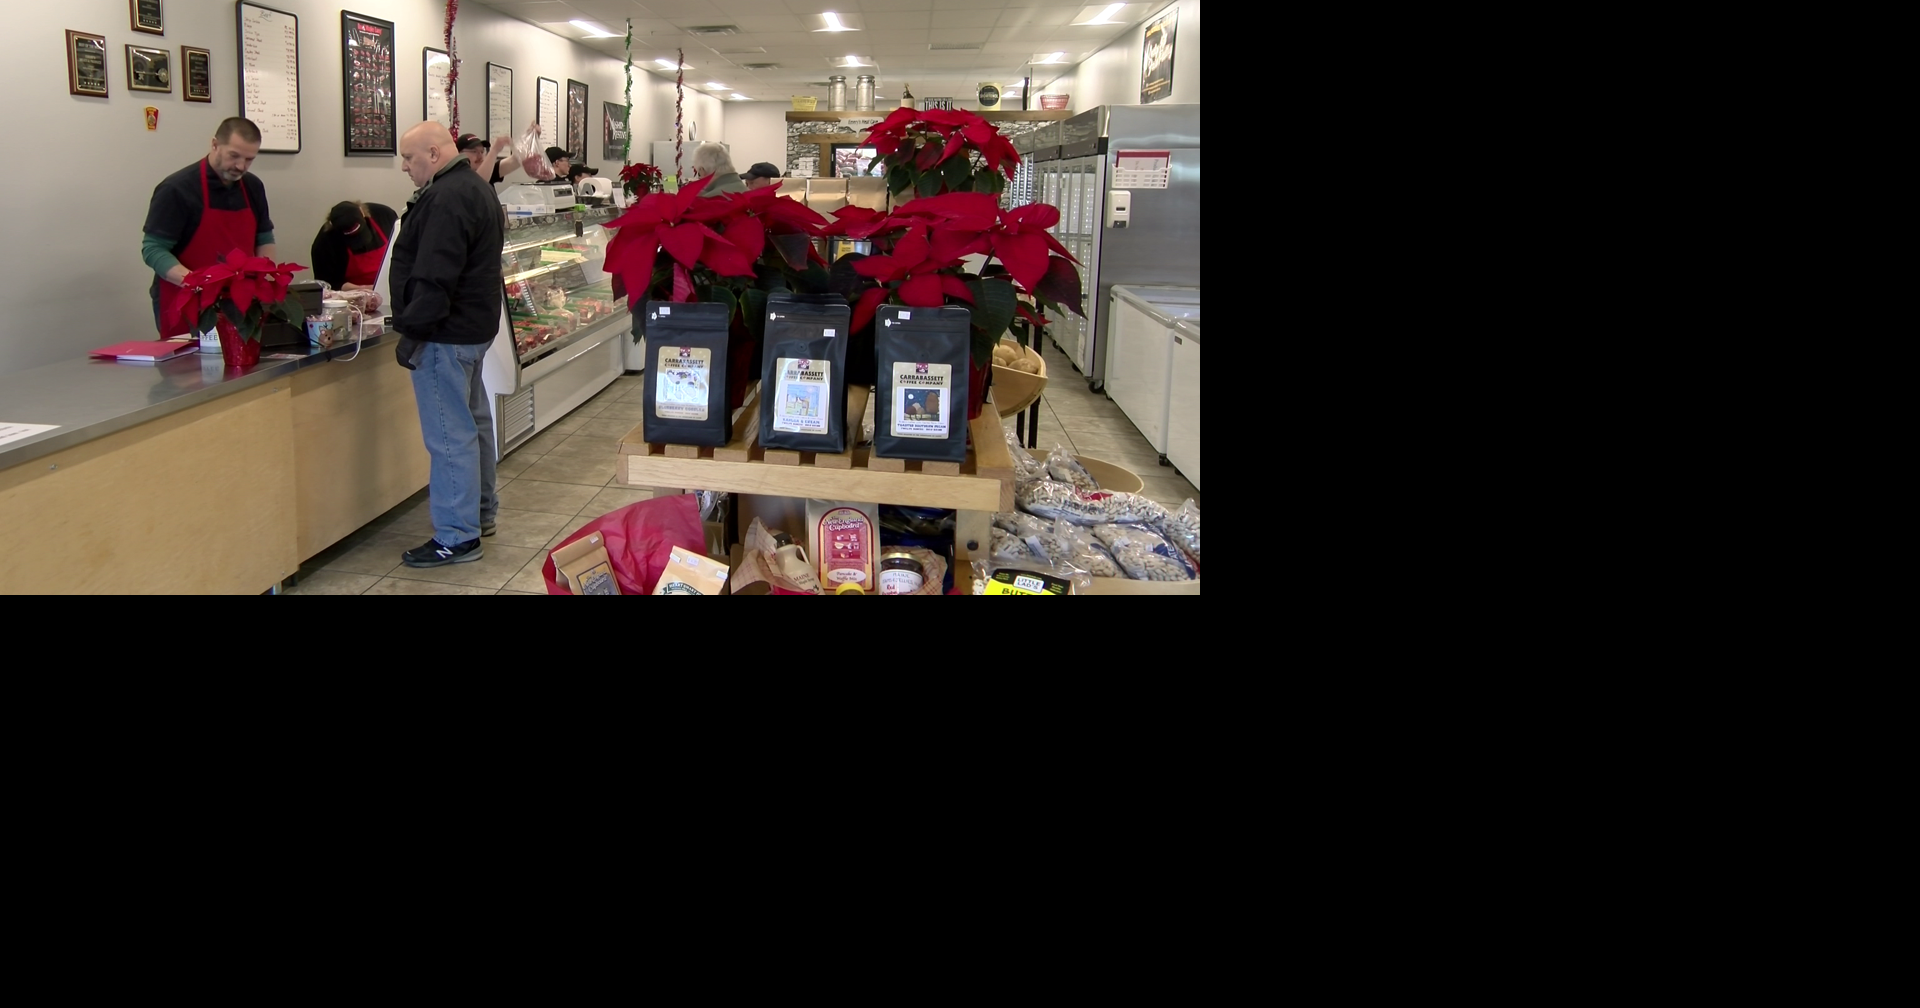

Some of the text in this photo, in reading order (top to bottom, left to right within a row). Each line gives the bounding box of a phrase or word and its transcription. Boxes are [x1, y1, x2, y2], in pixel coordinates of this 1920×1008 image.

[926, 100, 938, 110] THIS
[829, 523, 860, 531] Cupboard
[436, 546, 454, 558] N
[1018, 578, 1040, 586] LITTLE
